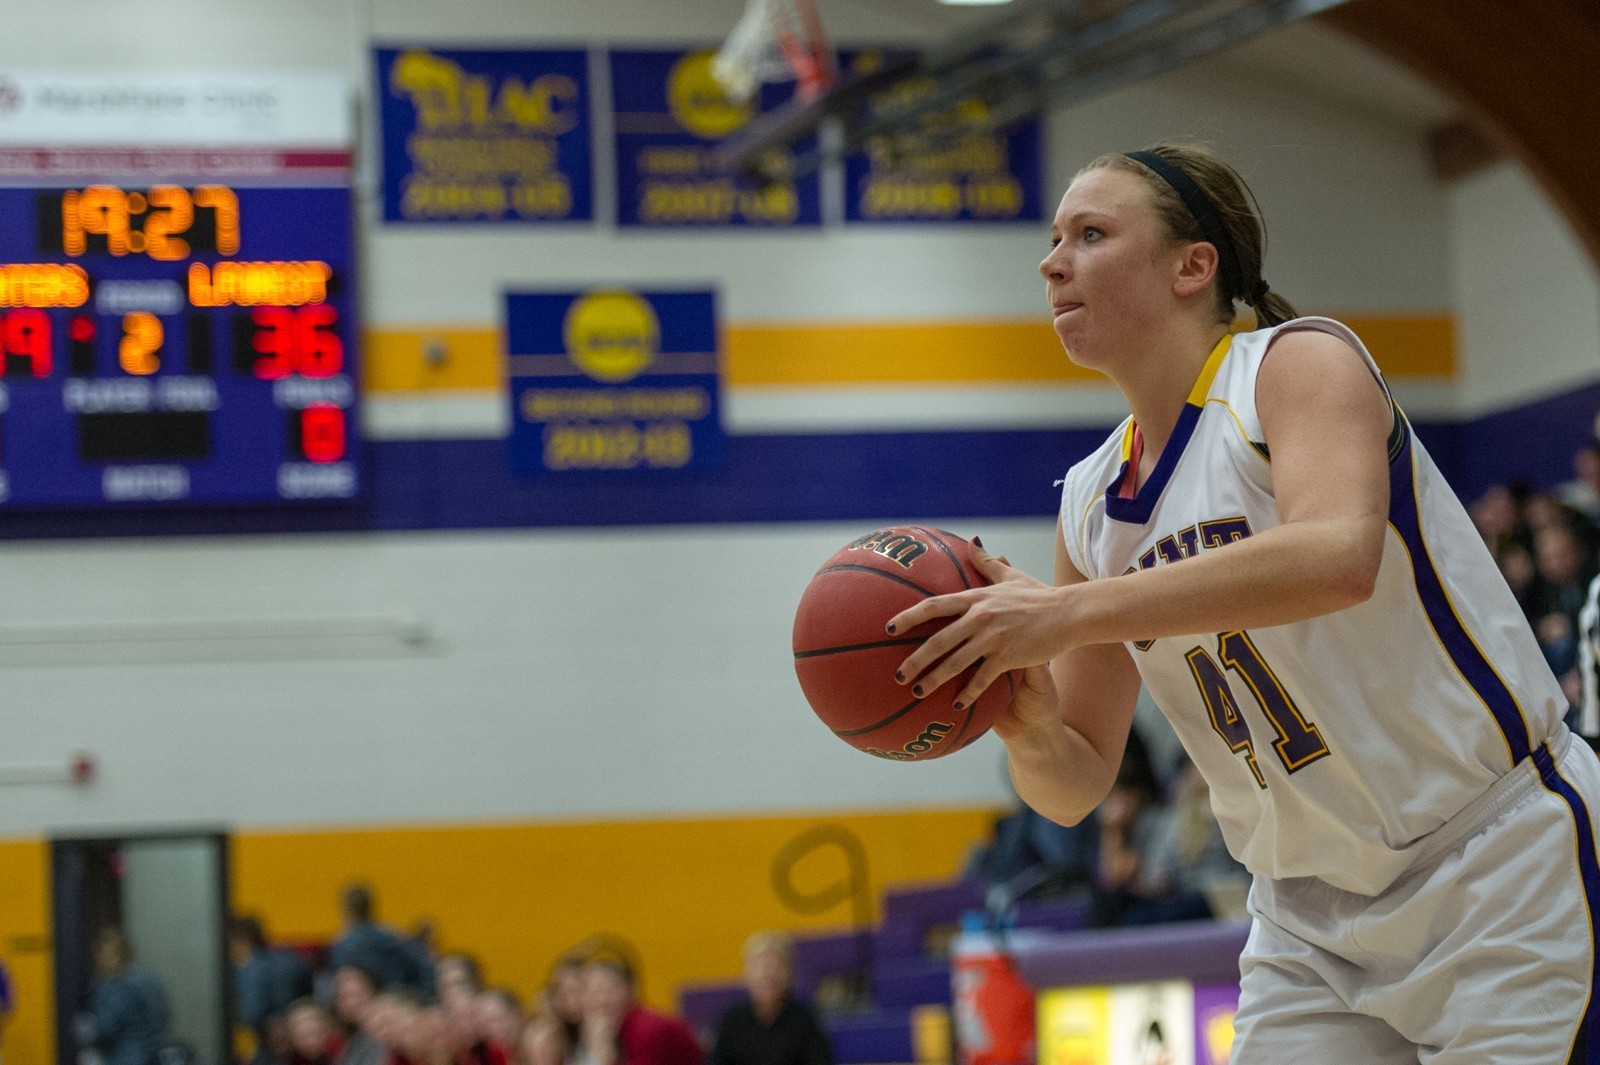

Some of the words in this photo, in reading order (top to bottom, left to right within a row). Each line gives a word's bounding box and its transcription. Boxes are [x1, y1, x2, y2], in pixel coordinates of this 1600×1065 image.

[62, 184, 239, 260] 19:27
[119, 311, 164, 375] 2
[252, 303, 344, 380] 36
[1184, 629, 1331, 790] 41
